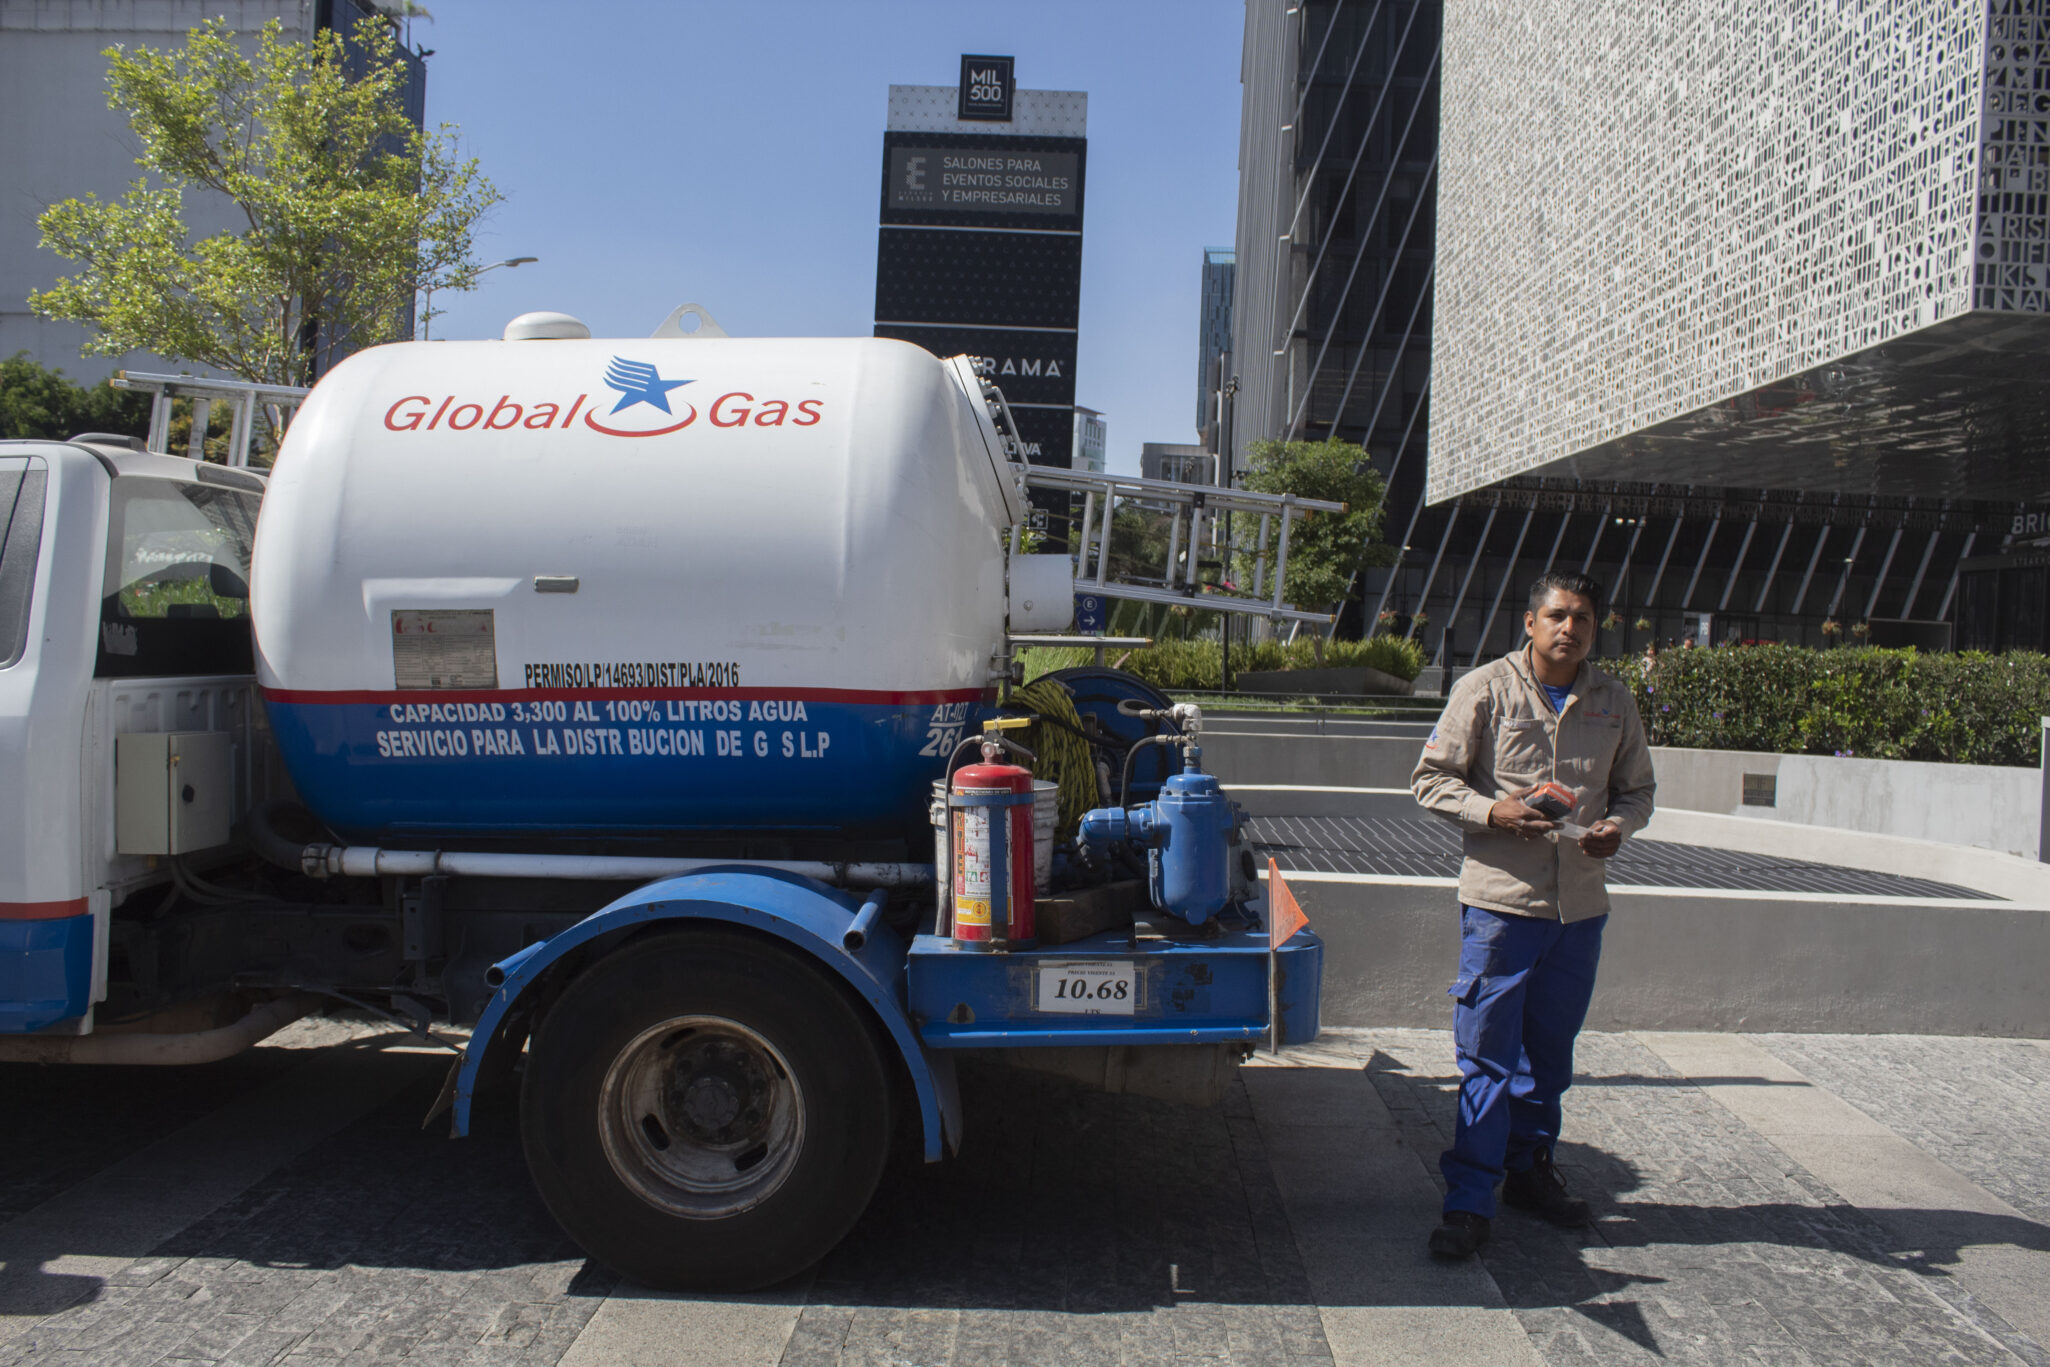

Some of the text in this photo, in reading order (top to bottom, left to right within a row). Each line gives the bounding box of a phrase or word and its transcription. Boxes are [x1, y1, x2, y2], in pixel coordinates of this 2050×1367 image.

[970, 69, 1002, 85] MIL
[970, 85, 1002, 101] 500
[943, 156, 1042, 172] SALONES PARA
[943, 173, 1069, 190] EVENTOS SOCIALES
[941, 190, 950, 202] Y
[953, 190, 1062, 206] EMPRESARIALES
[383, 391, 825, 432] Global Gas
[389, 700, 808, 723] CAPACIDAD 3,300 AL 100% LITROS AGUA
[376, 729, 468, 757] SERVICIO
[471, 729, 526, 756] PARA
[533, 728, 561, 755] LA
[715, 730, 743, 756] DE
[1054, 978, 1129, 1000] 10.68
